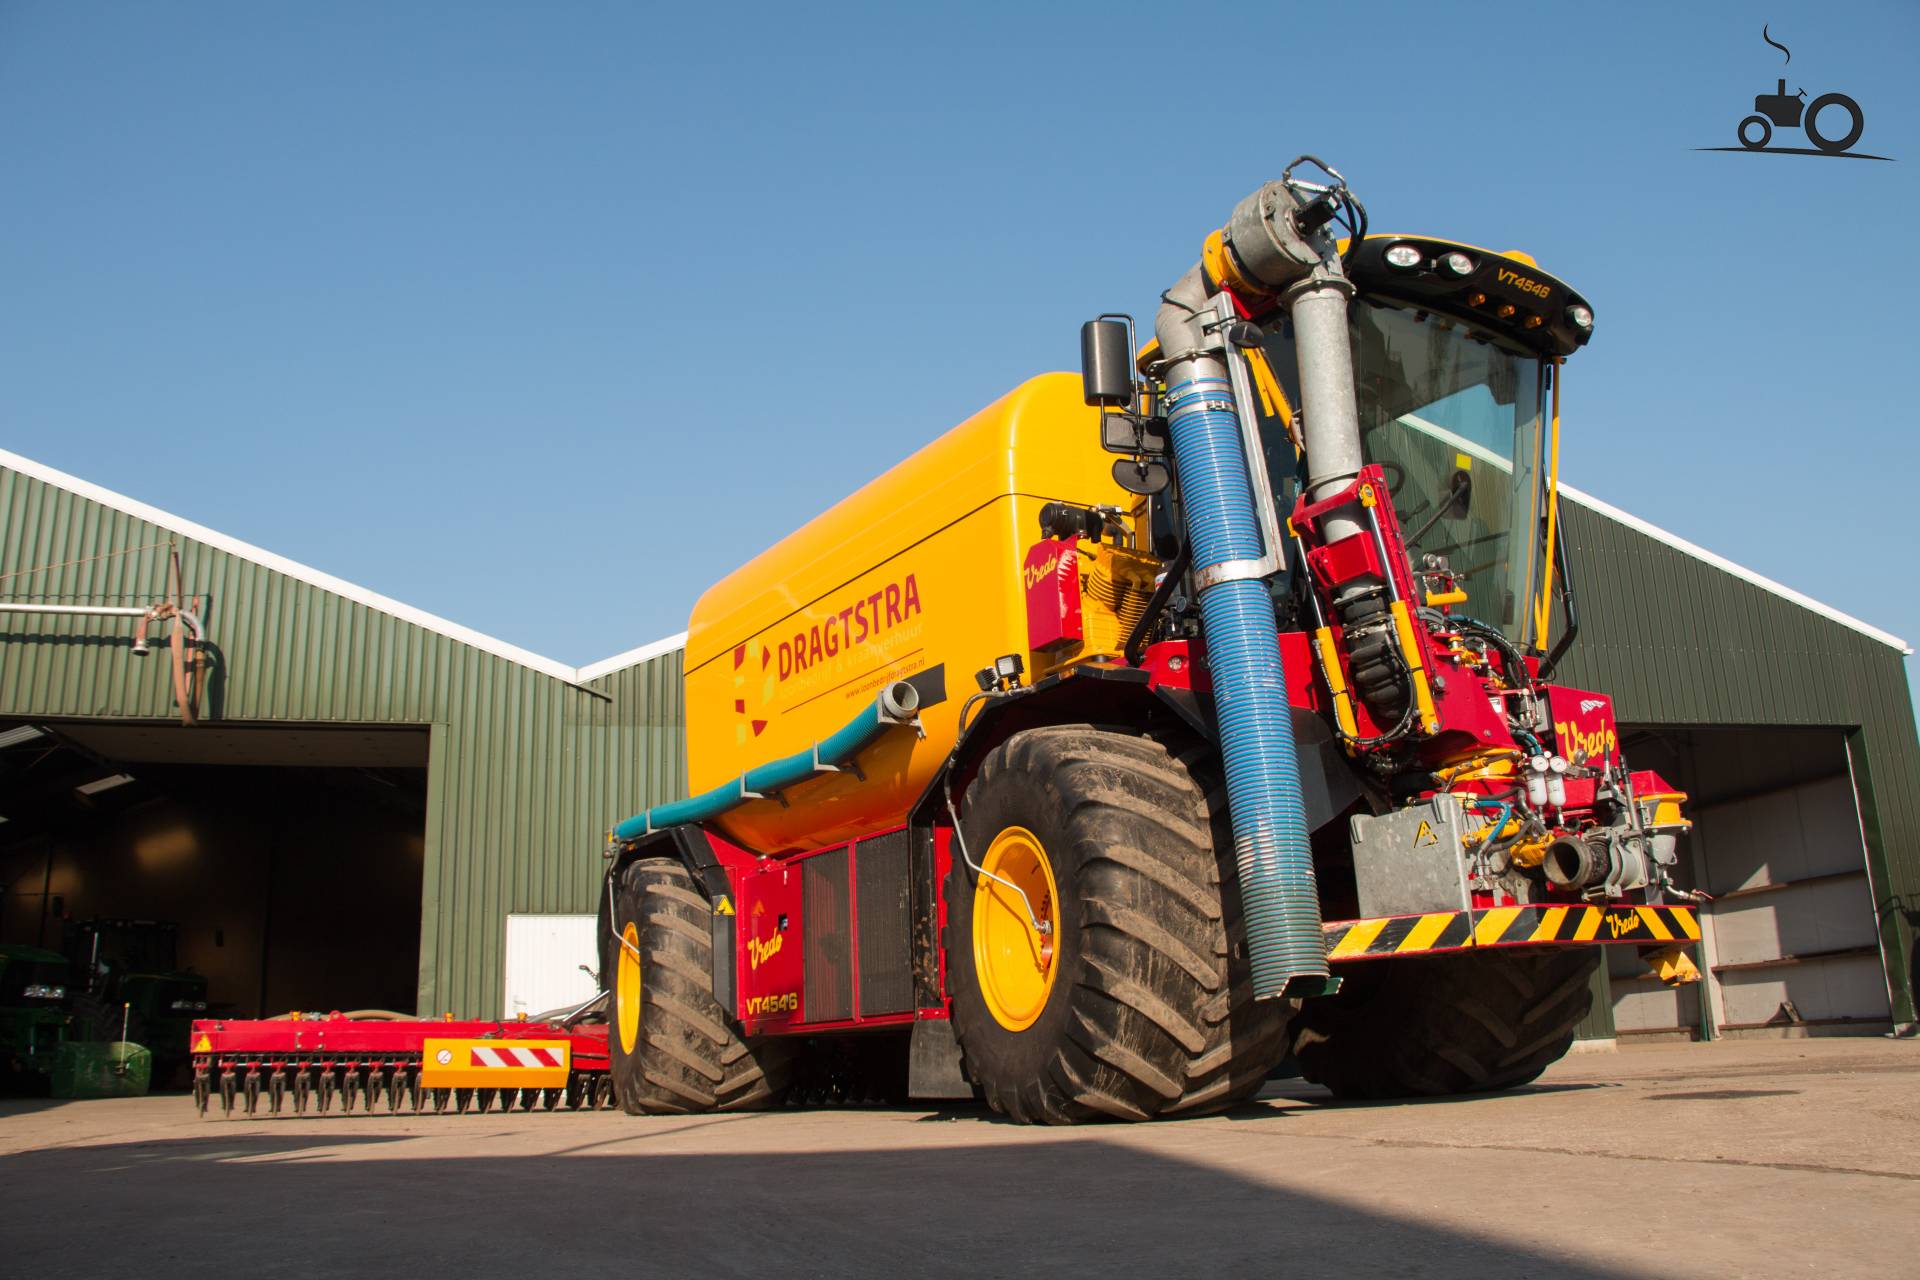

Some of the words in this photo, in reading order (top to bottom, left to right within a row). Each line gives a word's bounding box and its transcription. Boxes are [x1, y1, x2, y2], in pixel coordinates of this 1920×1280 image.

[1498, 267, 1551, 298] VT4546
[1024, 553, 1056, 589] Vredo
[778, 572, 922, 683] DRAGTSTRA
[1554, 718, 1615, 765] Vredo
[1605, 909, 1639, 939] Vredo
[747, 927, 783, 970] Vredo
[746, 992, 798, 1015] VT4546
